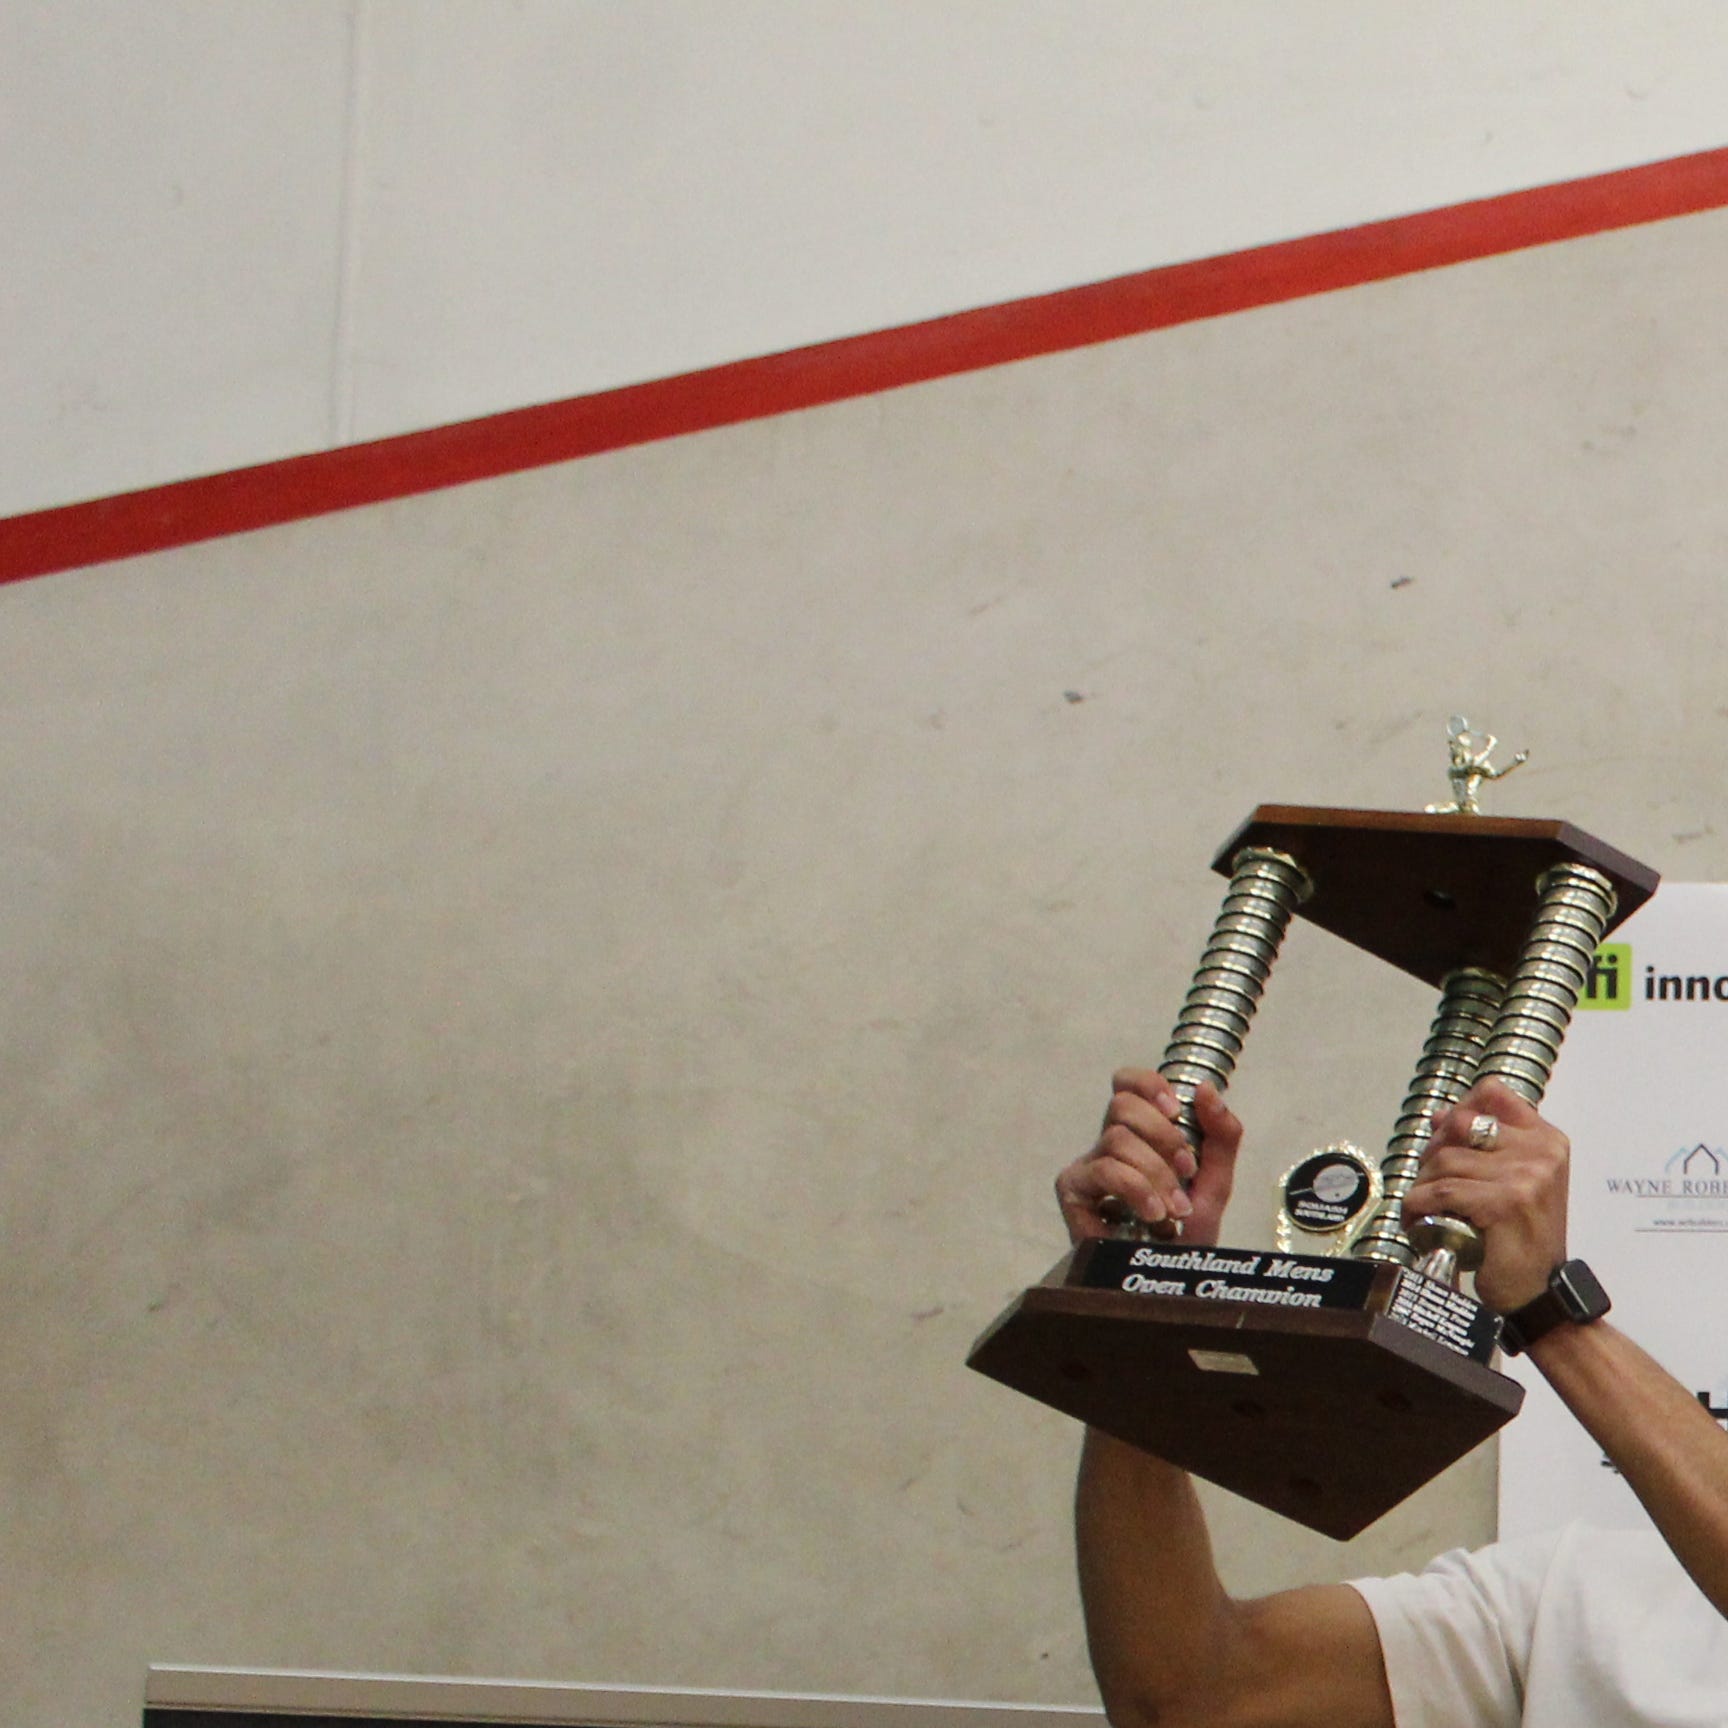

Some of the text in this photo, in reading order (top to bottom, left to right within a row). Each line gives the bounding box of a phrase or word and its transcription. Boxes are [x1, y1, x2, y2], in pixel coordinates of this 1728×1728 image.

[1607, 1179, 1673, 1195] WAYNE
[1129, 1248, 1335, 1282] Southland Mens
[1121, 1274, 1322, 1308] Open Champion
